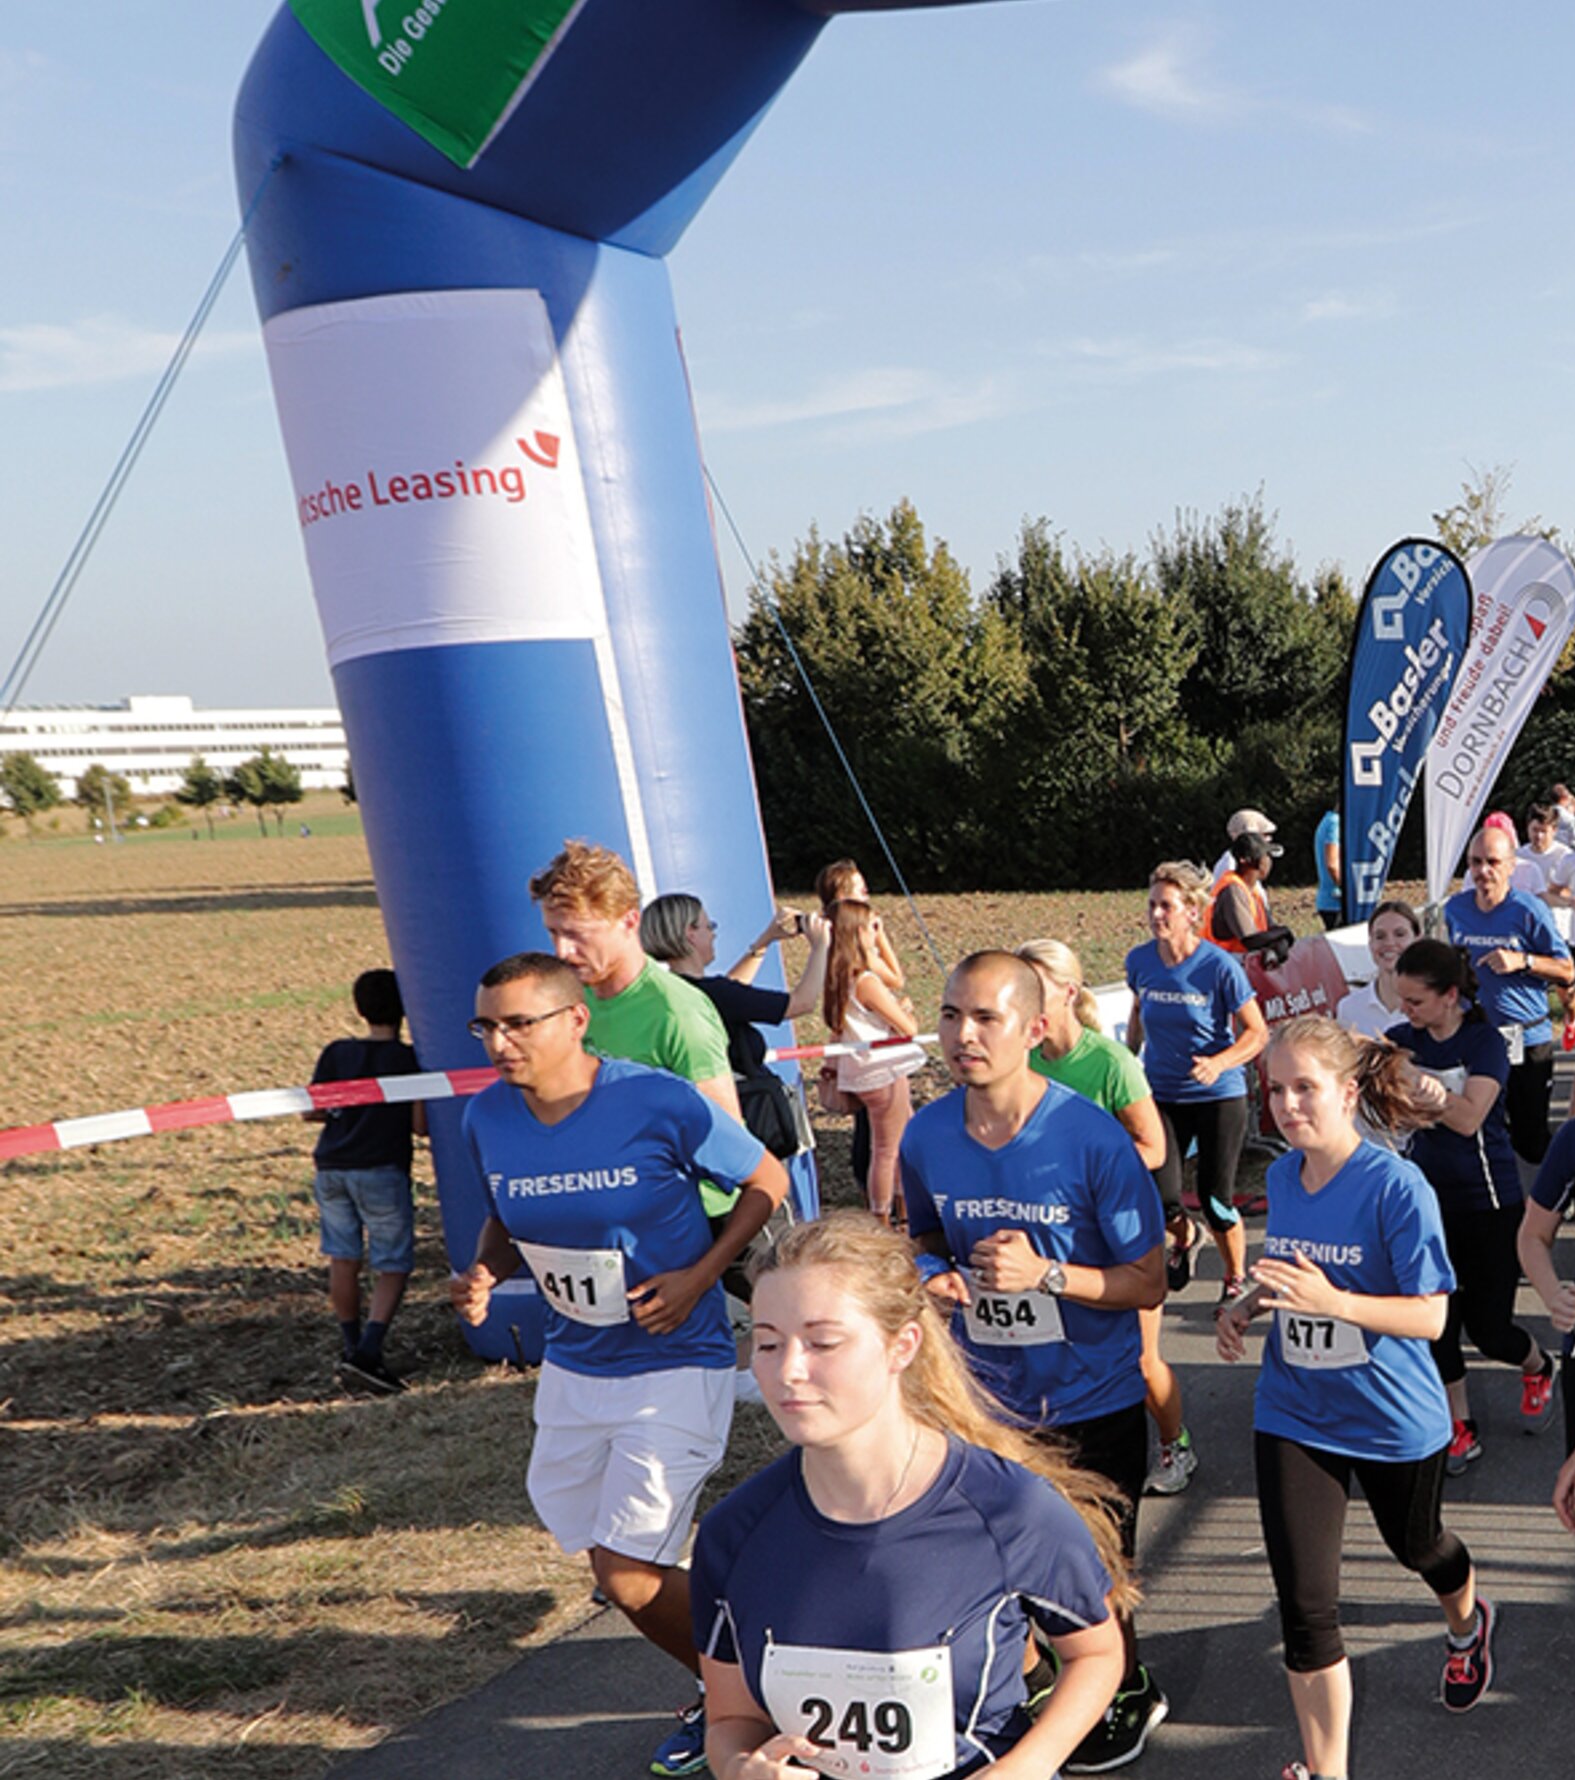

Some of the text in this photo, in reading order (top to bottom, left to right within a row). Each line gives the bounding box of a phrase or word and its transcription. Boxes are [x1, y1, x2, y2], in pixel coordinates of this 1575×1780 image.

[402, 0, 446, 40] Ges
[299, 459, 526, 528] tsche Leasing
[1367, 618, 1450, 741] Basler
[1436, 602, 1515, 749] und Freude dabei!
[1434, 635, 1536, 800] DORNBACH
[508, 1166, 639, 1199] FRESENIUS
[953, 1198, 1071, 1225] FRESENIUS
[543, 1271, 597, 1306] 411
[974, 1296, 1037, 1328] 454
[1286, 1317, 1335, 1350] 477
[800, 1696, 913, 1755] 249
